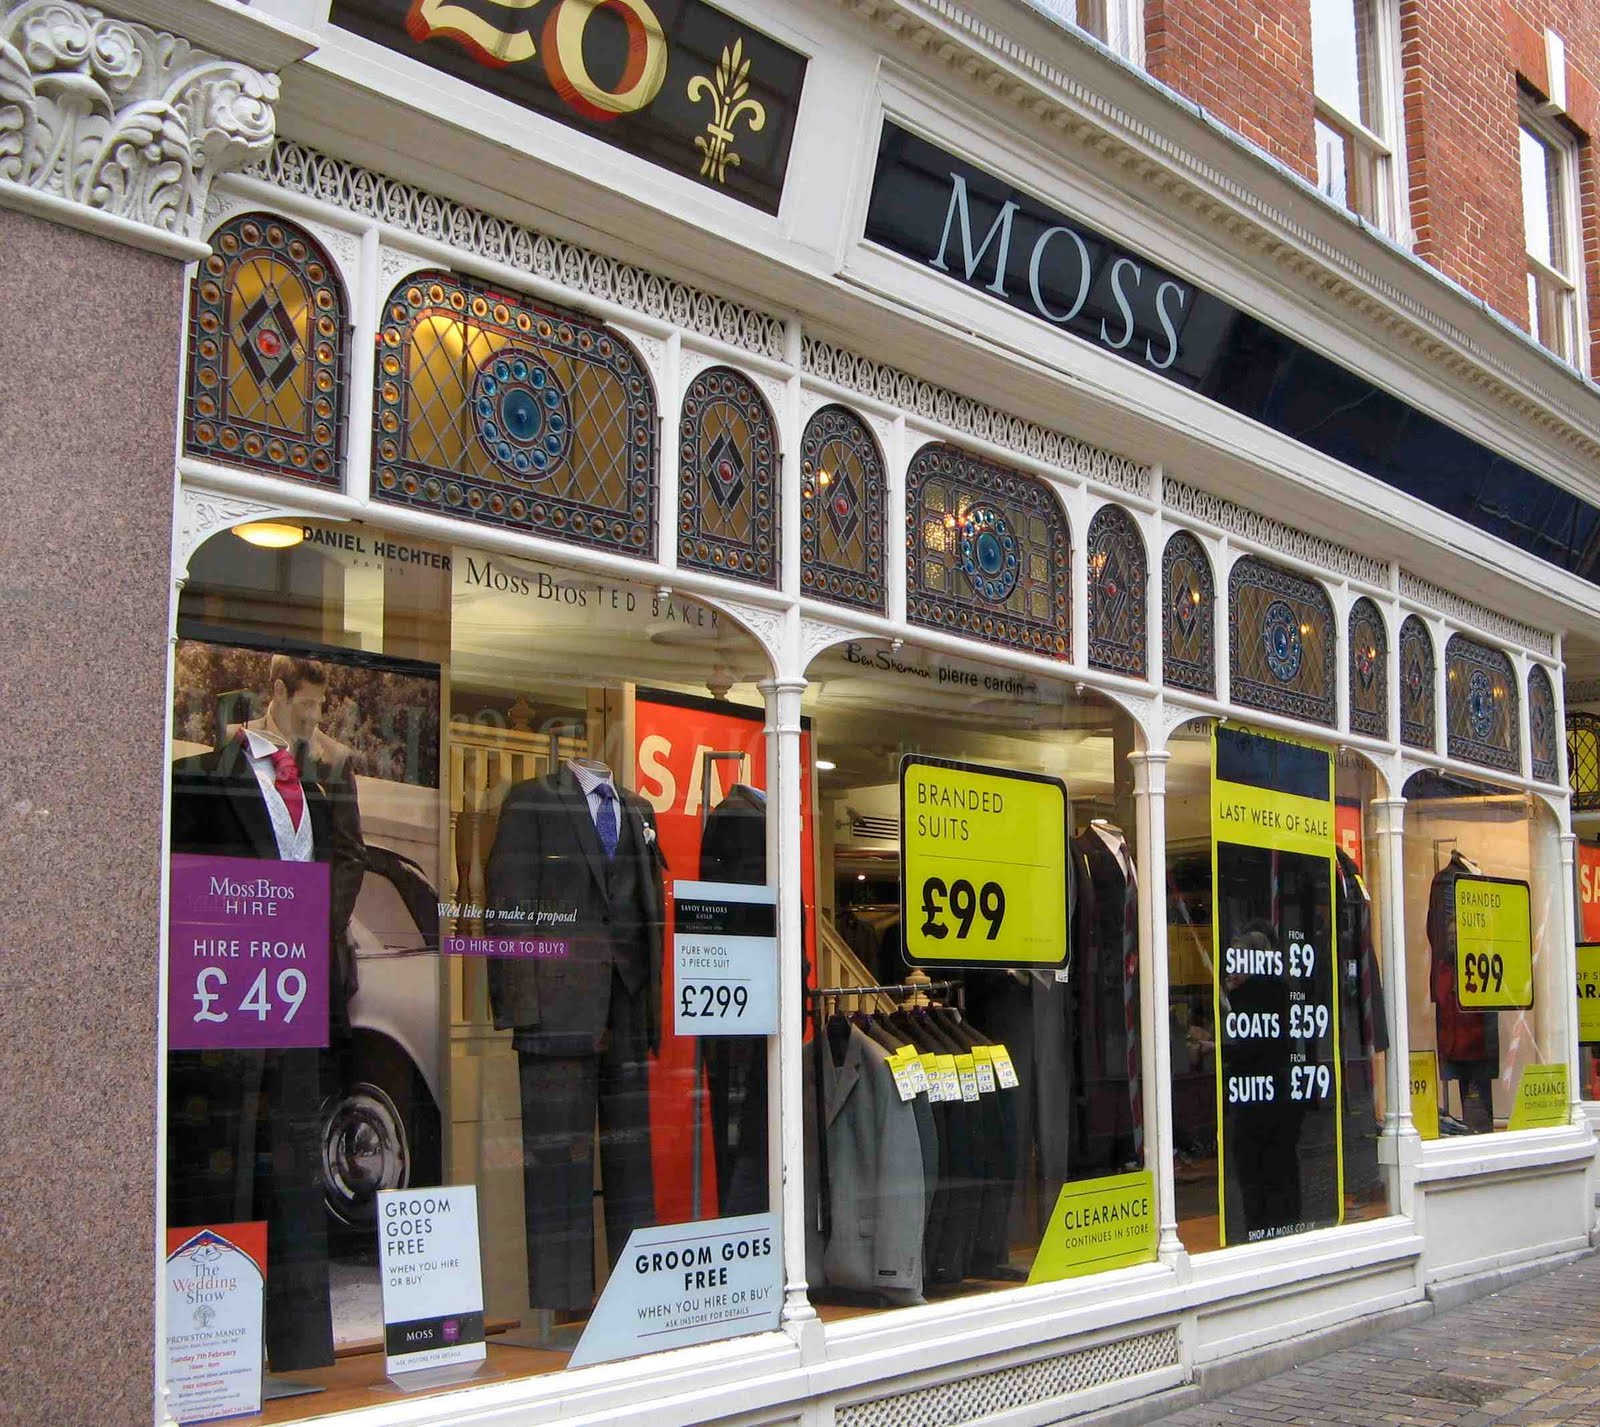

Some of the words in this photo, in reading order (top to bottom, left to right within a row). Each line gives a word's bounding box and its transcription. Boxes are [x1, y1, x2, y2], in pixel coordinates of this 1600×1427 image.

[929, 172, 1185, 369] MOSS
[303, 525, 366, 553] DANIEL
[374, 541, 451, 571] HECHTER
[465, 557, 529, 595] Moss
[538, 572, 587, 607] Bros
[597, 586, 636, 611] TED
[652, 598, 718, 629] BAKER
[841, 642, 875, 668] Ben
[938, 666, 978, 687] pierre
[984, 675, 1024, 695] cardin
[918, 782, 1004, 814] BRANDED
[917, 814, 970, 841] SUITS
[1219, 802, 1246, 821] LAST
[1251, 808, 1281, 828] WEEK
[1286, 815, 1300, 831] OF
[1304, 818, 1328, 836] SALE
[209, 877, 255, 898] Moss
[256, 879, 295, 900] Bros
[226, 900, 278, 916] HIRE
[921, 876, 1006, 941] £99
[1461, 891, 1501, 908] BRANDED
[463, 904, 482, 918] like
[485, 908, 495, 919] to
[498, 906, 525, 920] make
[528, 912, 534, 920] a
[535, 909, 578, 926] proposal
[1461, 912, 1486, 928] SUITS
[1288, 930, 1305, 940] FROM
[194, 939, 239, 958] HIRE
[250, 941, 306, 959] FROM
[449, 940, 465, 951] TO
[470, 940, 494, 952] HIRE
[499, 941, 515, 953] OR
[520, 941, 535, 953] TO
[538, 942, 565, 954] BUY?
[681, 946, 701, 955] PURE
[703, 947, 728, 956] WOOL
[682, 959, 687, 967] 3
[689, 959, 710, 968] PIECE
[713, 960, 730, 968] SUIT
[1226, 947, 1284, 976] SHIRTS
[1289, 943, 1315, 978] £9
[1465, 952, 1504, 994] £99
[681, 985, 748, 1018] £299
[1290, 992, 1306, 1001] FROM
[1226, 1012, 1280, 1039] COATS
[1289, 1004, 1329, 1039] £59
[1290, 1053, 1306, 1062] FROM
[1229, 1075, 1275, 1103] SUITS
[1291, 1065, 1330, 1100] £79
[1524, 1081, 1566, 1097] CLEARANCE
[385, 1198, 451, 1217] GROOM
[1065, 1198, 1148, 1230] CLEARANCE
[386, 1218, 432, 1237] GOES
[1065, 1230, 1112, 1249] CONTINUES
[1114, 1229, 1123, 1239] IN
[1126, 1223, 1149, 1237] STORE
[1248, 1229, 1265, 1241] SHOP
[1266, 1227, 1275, 1238] AT
[388, 1238, 425, 1256] FREE
[636, 1246, 712, 1274] GROOM
[722, 1237, 771, 1261] GOES
[192, 1263, 220, 1277] The
[389, 1264, 416, 1274] WHEN
[419, 1262, 438, 1271] YOU
[441, 1259, 459, 1269] HIRE
[173, 1275, 237, 1292] Wedding
[390, 1278, 403, 1287] OR
[685, 1267, 728, 1291] FREE
[186, 1290, 225, 1304] Show
[637, 1305, 671, 1319] WHEN
[676, 1300, 700, 1313] YOU
[704, 1294, 727, 1308] HIRE
[732, 1291, 746, 1304] OR
[680, 1315, 708, 1326] INSTORE
[710, 1311, 723, 1320] FOR
[725, 1306, 749, 1317] DETAILS
[215, 1327, 247, 1338] MANOR
[406, 1329, 434, 1341] MOSS
[208, 1350, 237, 1359] February
